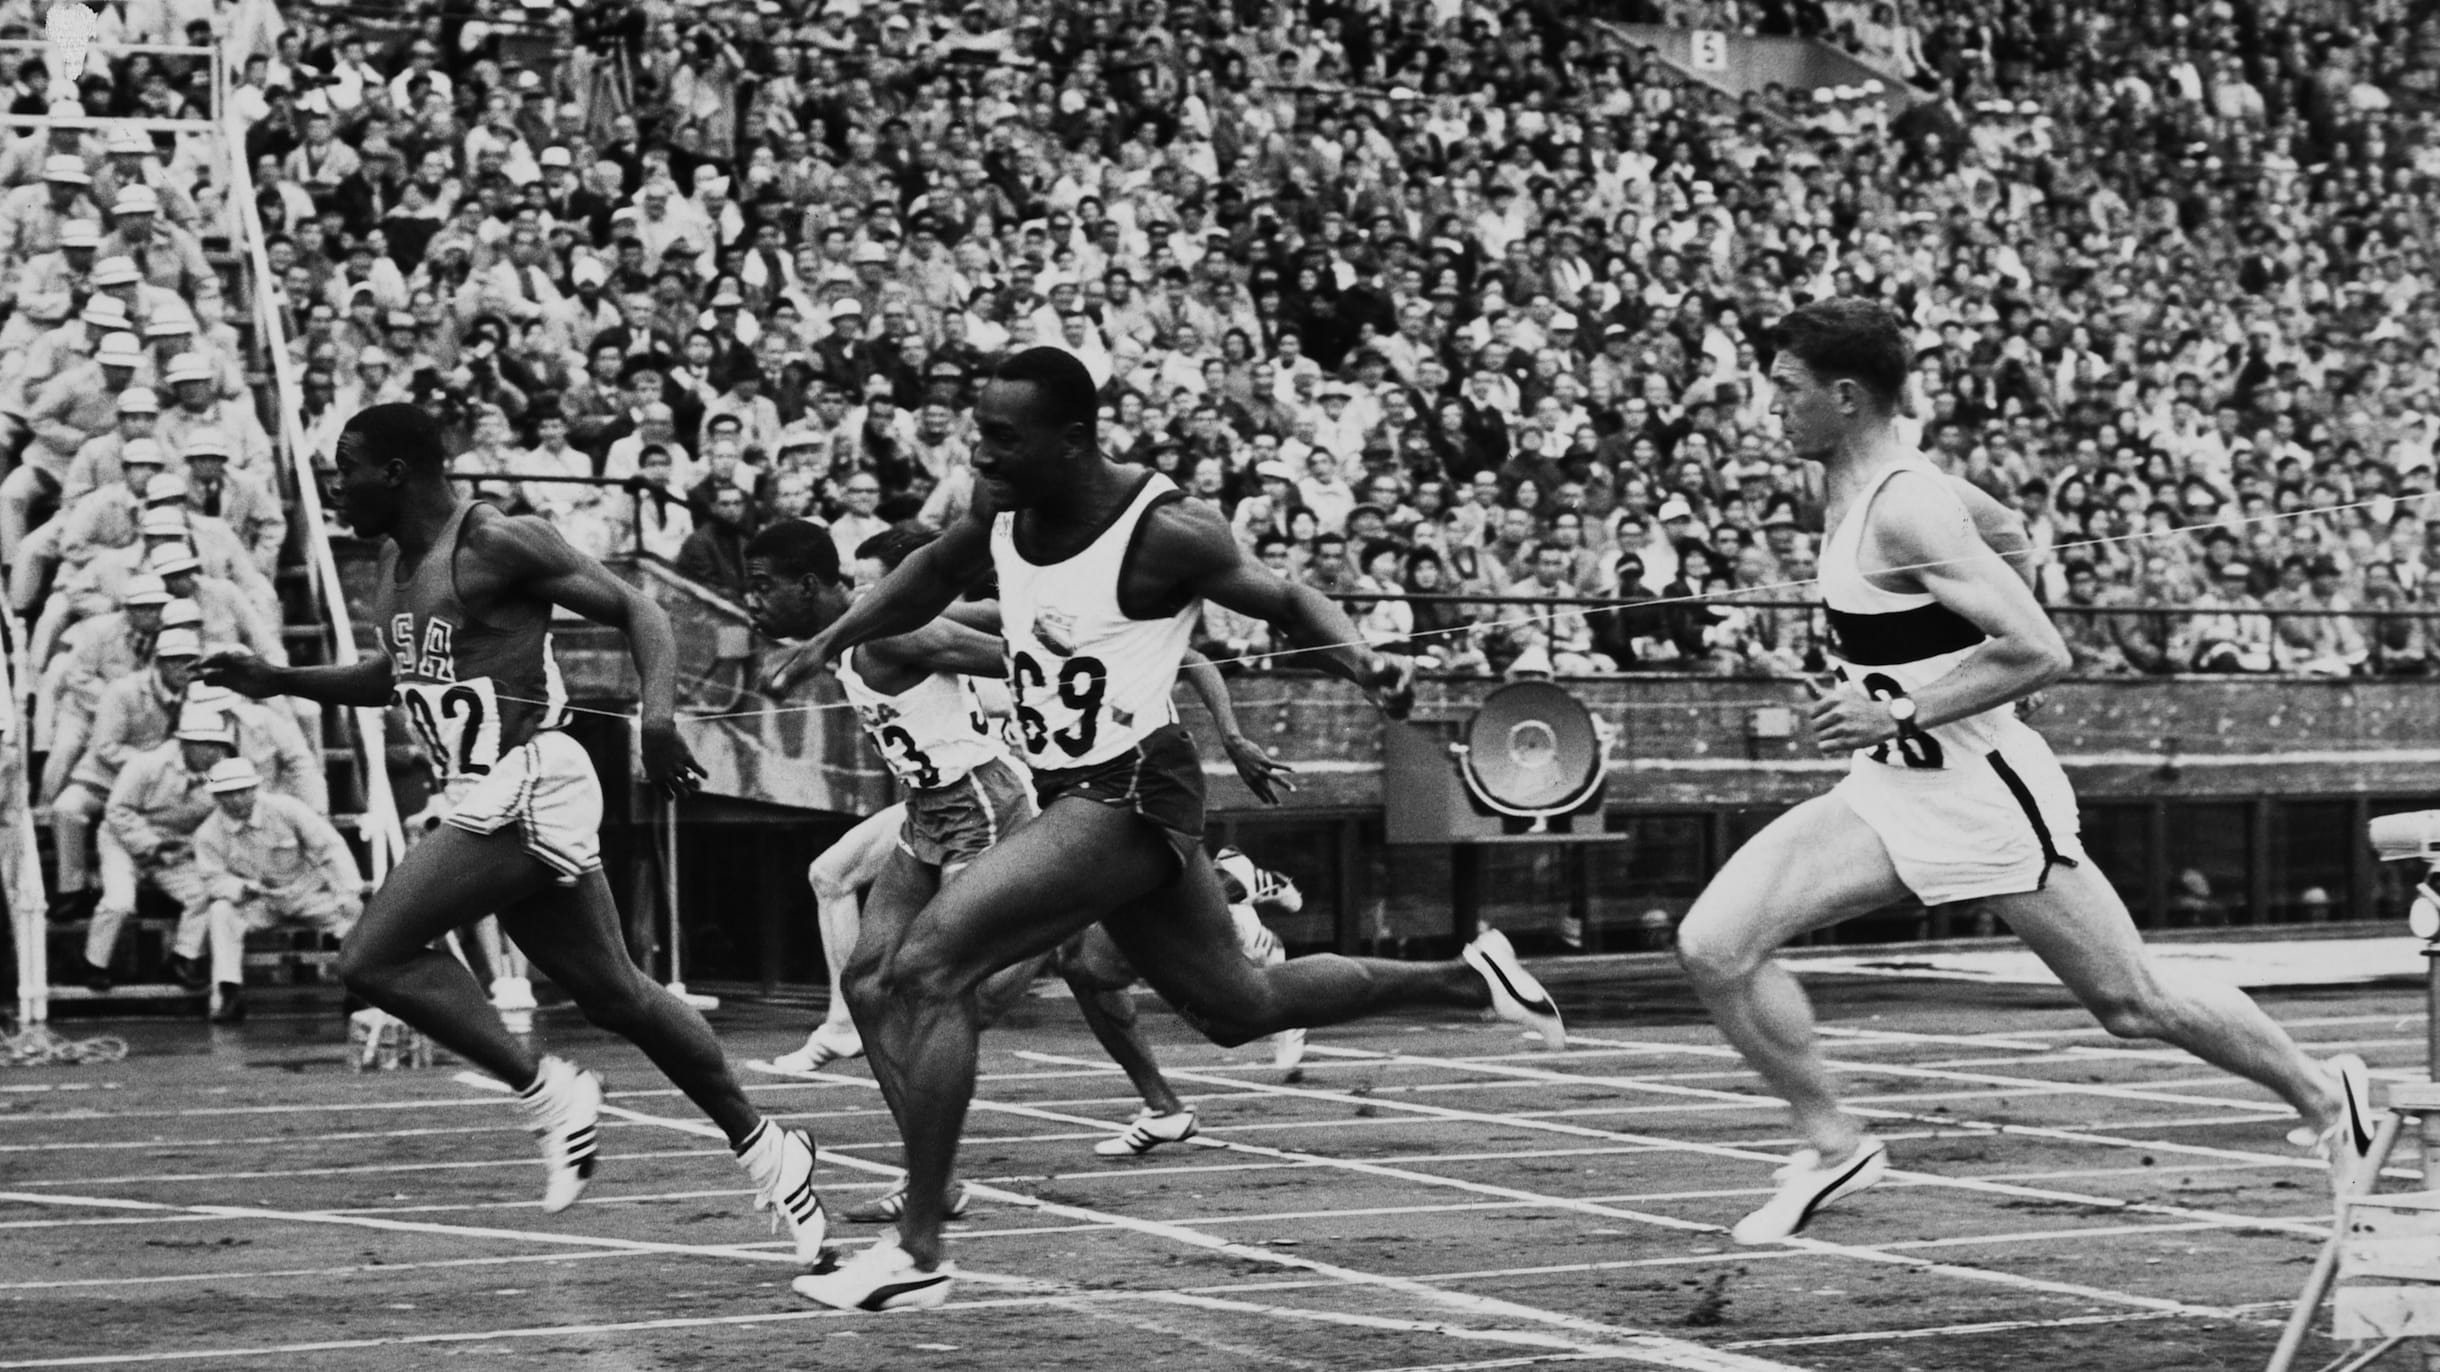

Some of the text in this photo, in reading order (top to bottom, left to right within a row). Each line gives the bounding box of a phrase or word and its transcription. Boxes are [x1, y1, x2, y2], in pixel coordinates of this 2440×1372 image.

[1702, 34, 1718, 63] 5
[375, 612, 456, 683] SA
[1014, 651, 1107, 758] 69
[870, 725, 941, 787] 3
